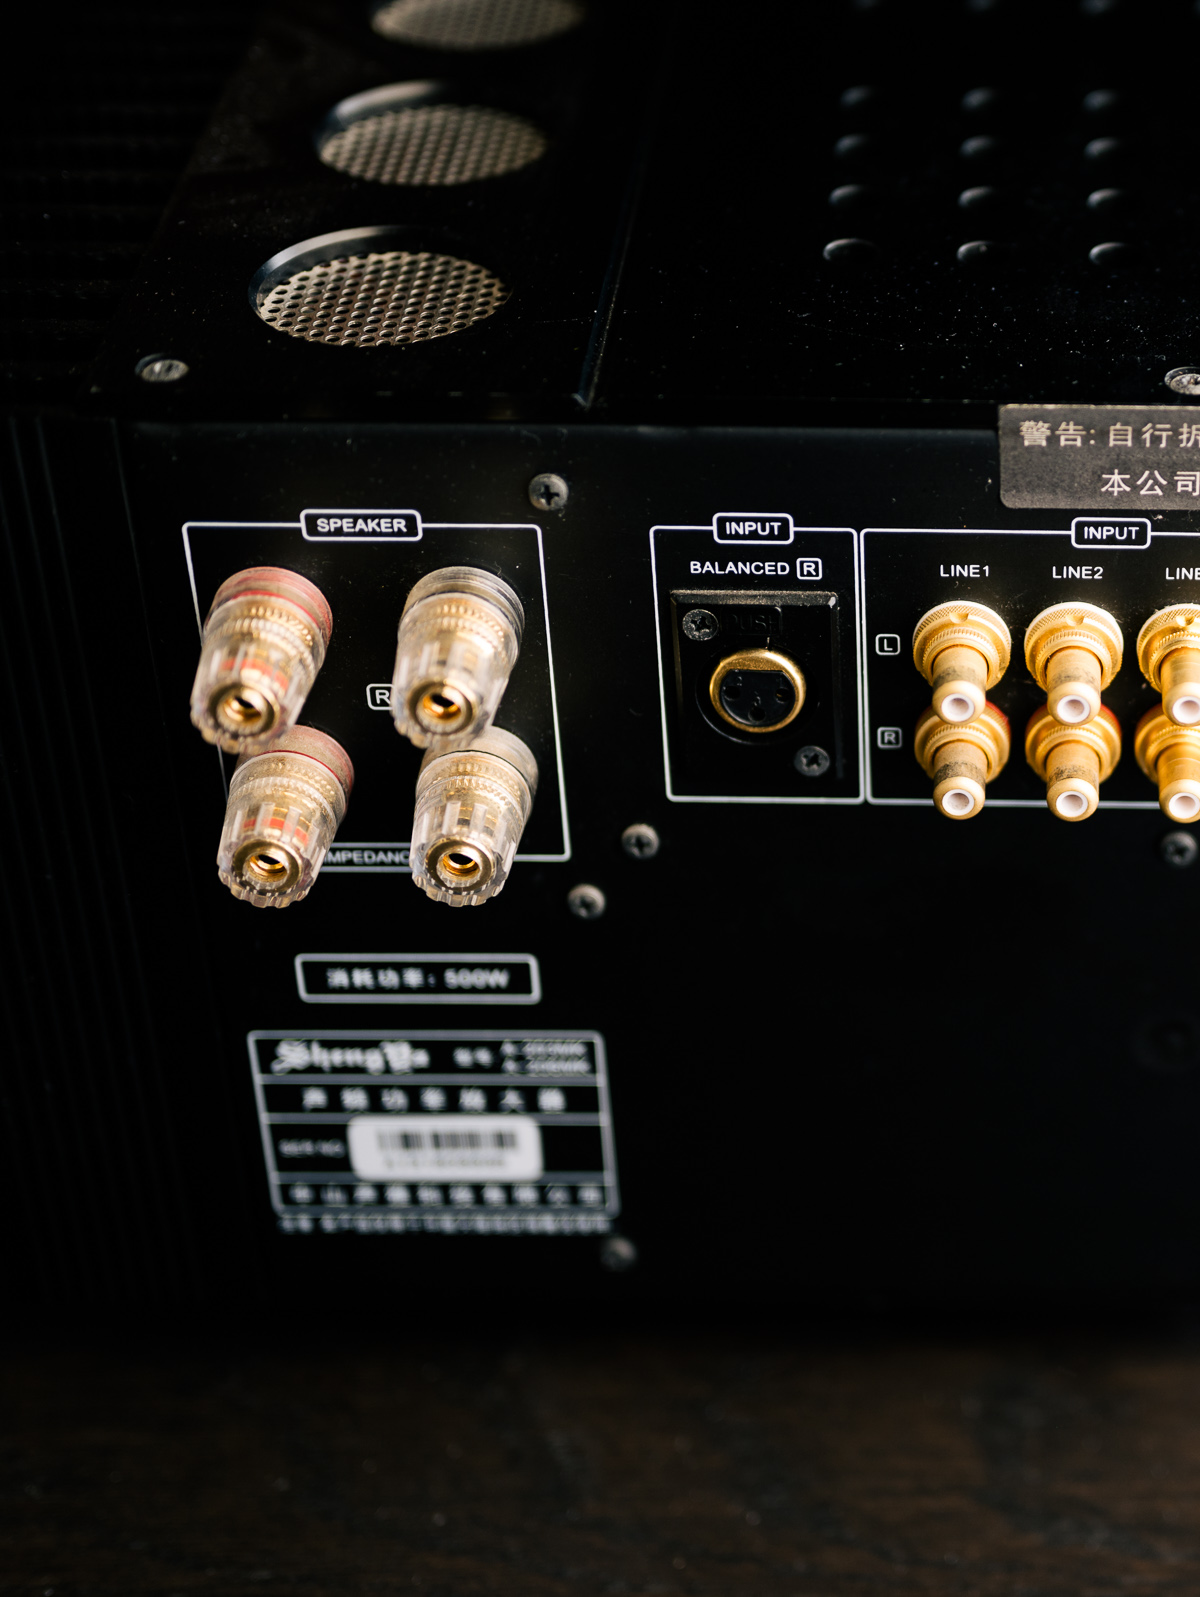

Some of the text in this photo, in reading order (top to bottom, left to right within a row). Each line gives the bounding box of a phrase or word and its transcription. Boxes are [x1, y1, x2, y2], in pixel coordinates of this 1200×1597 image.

[316, 517, 408, 533] SPEAKER
[725, 521, 782, 536] INPUT
[1083, 526, 1140, 541] INPUT
[689, 560, 817, 576] BALANCED R
[939, 564, 990, 578] LINE1
[1052, 565, 1104, 580] LINE2
[883, 639, 893, 651] L
[375, 689, 391, 705] R
[884, 732, 896, 744] R
